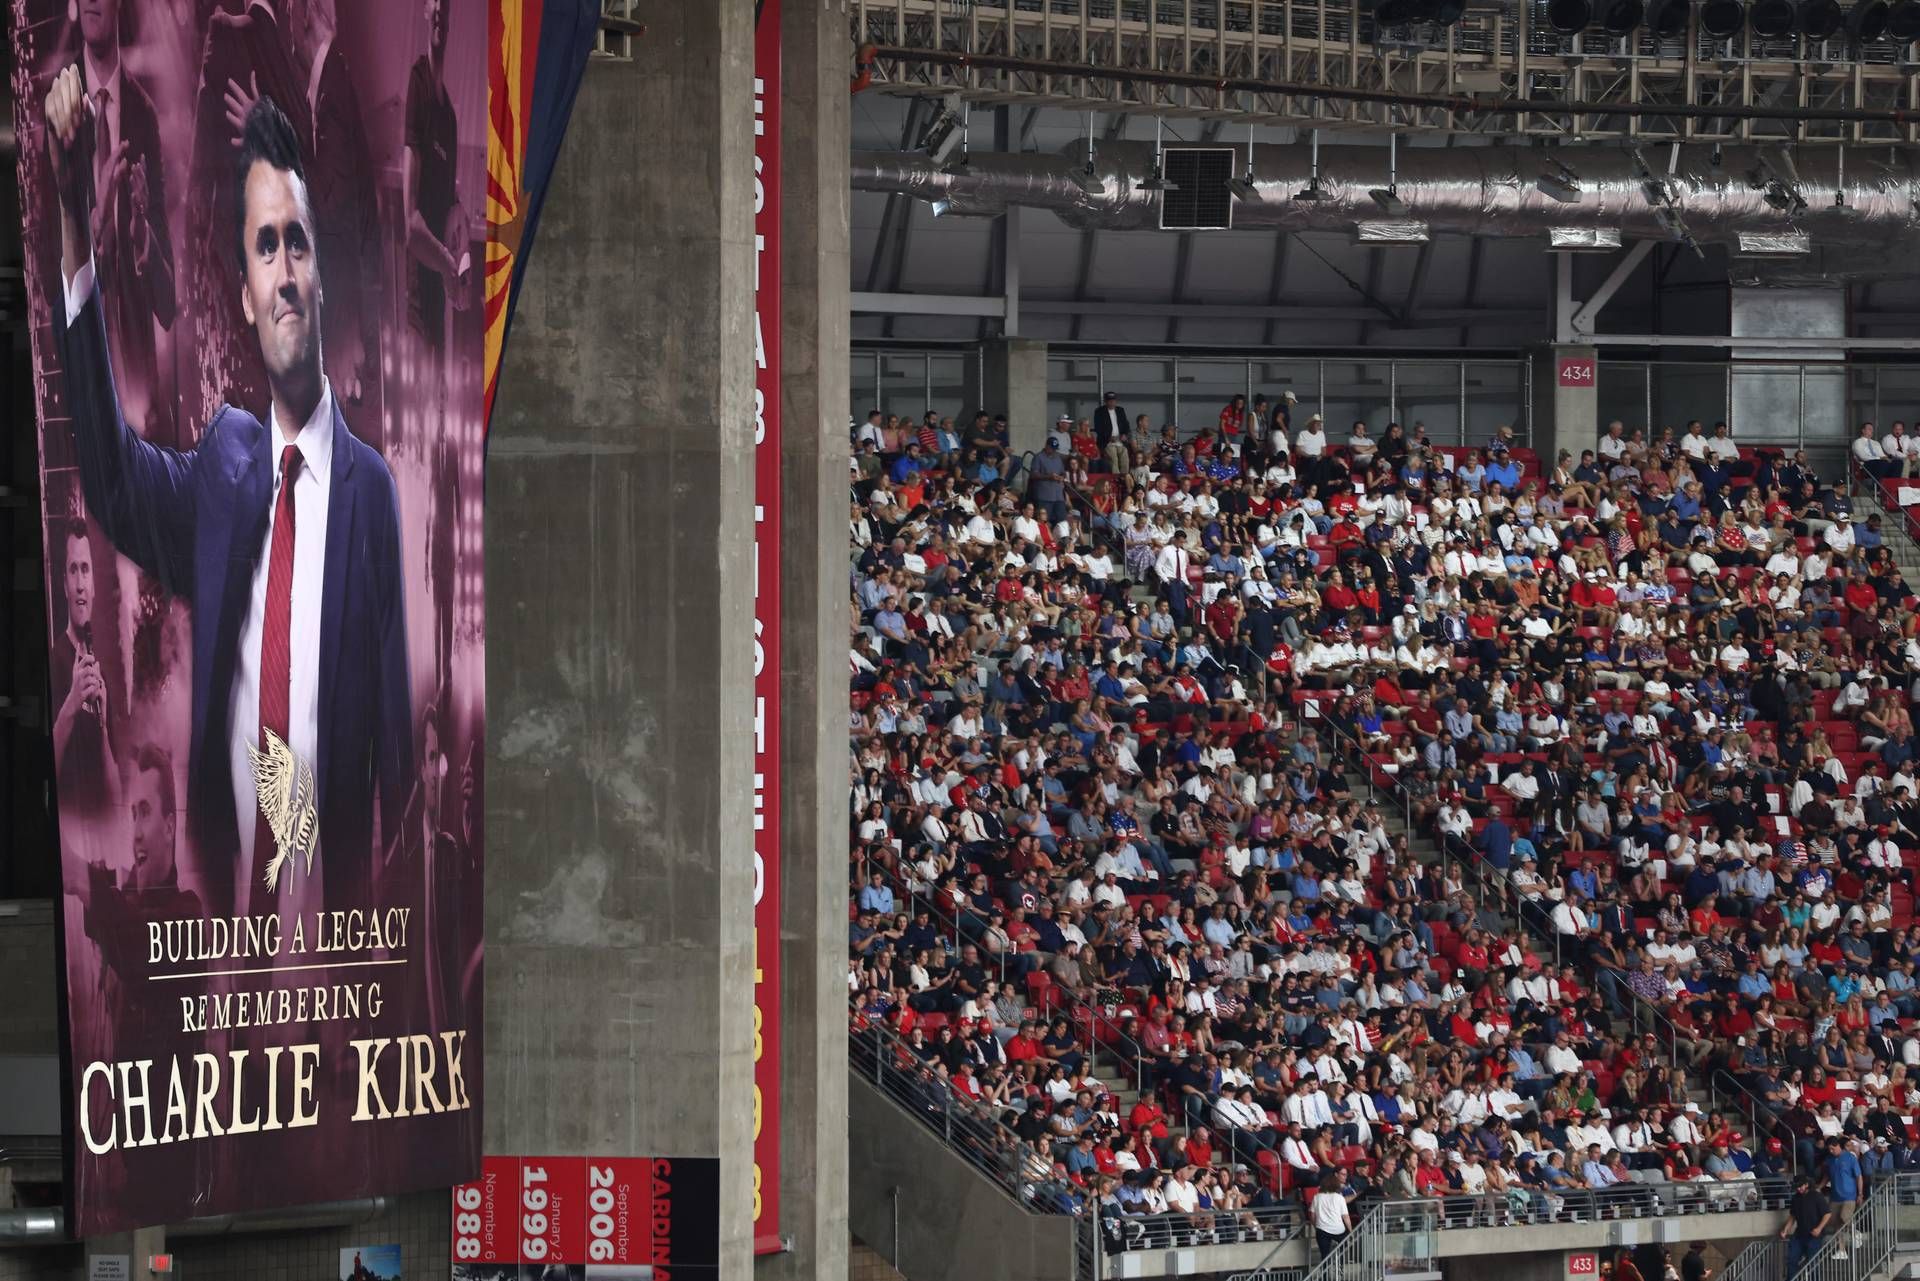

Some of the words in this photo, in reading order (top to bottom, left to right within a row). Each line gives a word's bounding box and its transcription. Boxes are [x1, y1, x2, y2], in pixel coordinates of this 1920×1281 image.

[1562, 366, 1591, 380] 434
[147, 913, 282, 963] BUILDING
[289, 912, 306, 954] A
[315, 907, 410, 952] LEGACY
[180, 982, 383, 1032] REMEMBERING
[80, 1043, 320, 1155] CHARLIE
[350, 1030, 470, 1121] KIRK
[456, 1184, 481, 1259] 988
[484, 1173, 497, 1247] November
[523, 1166, 548, 1260] 1999
[550, 1193, 562, 1247] January
[590, 1166, 615, 1261] 2006
[617, 1184, 630, 1262] September
[484, 1251, 496, 1260] 6
[551, 1252, 563, 1261] 2
[1573, 1258, 1592, 1271] 433
